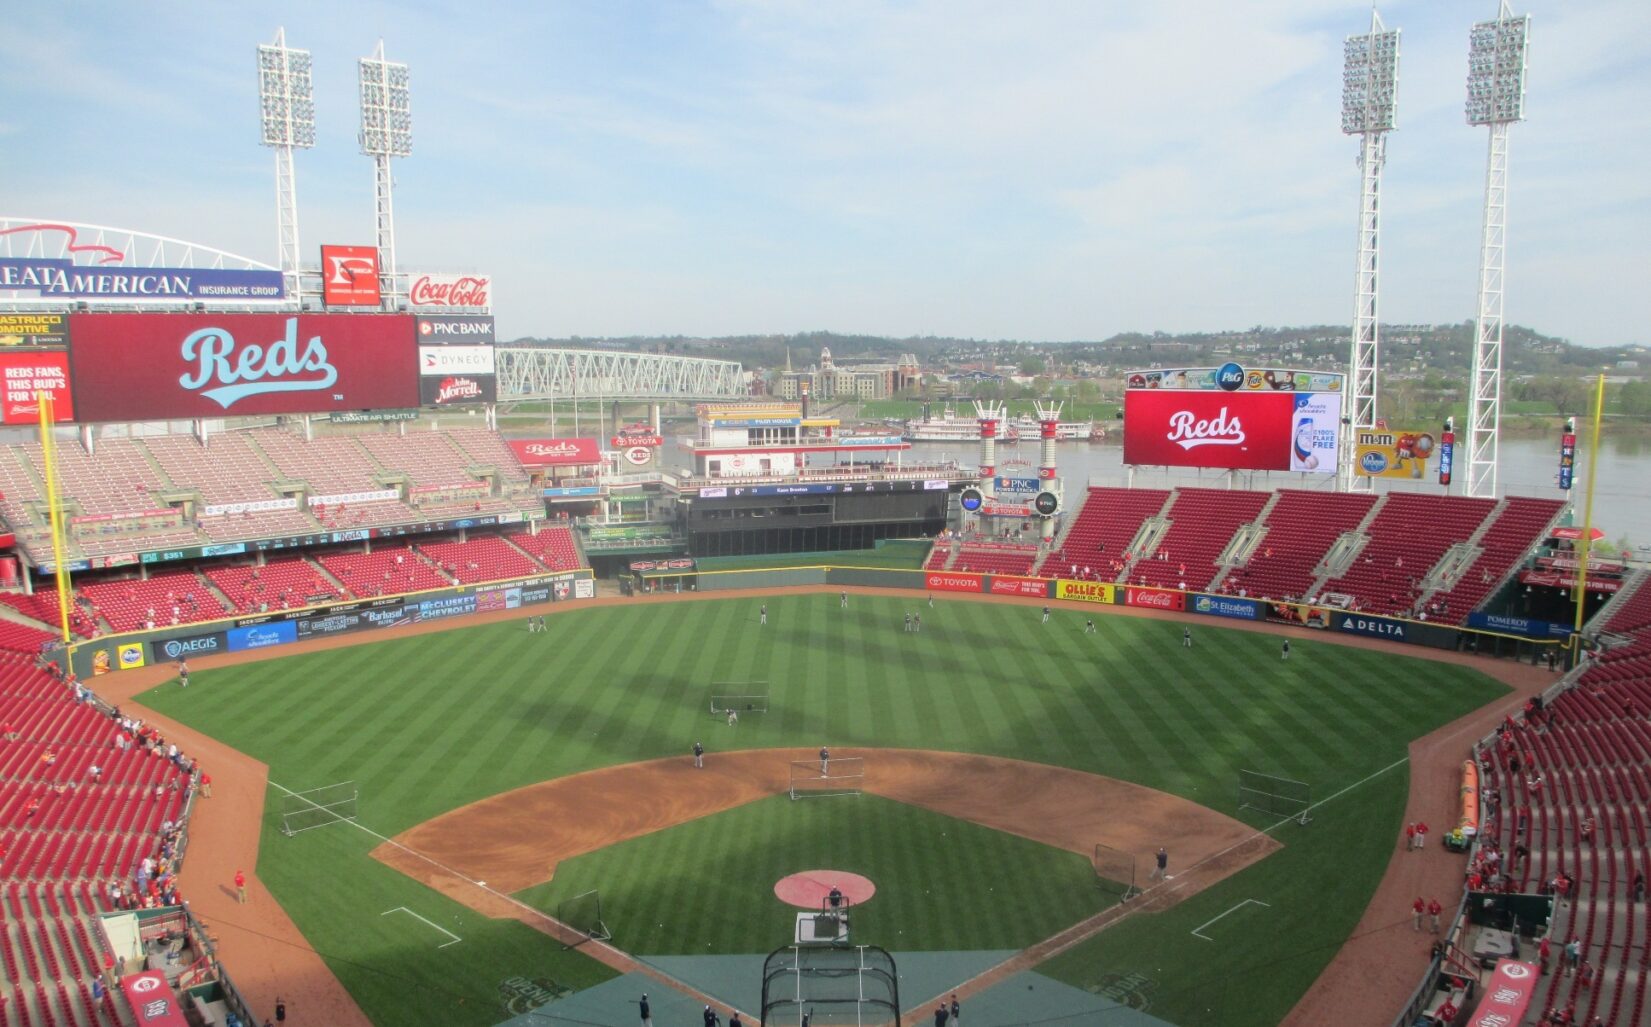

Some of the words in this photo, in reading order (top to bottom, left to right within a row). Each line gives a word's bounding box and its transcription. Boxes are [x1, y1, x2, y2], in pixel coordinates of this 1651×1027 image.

[0, 266, 55, 285] EAT
[48, 269, 191, 294] AMERICAN
[200, 286, 249, 295] INSURANCE
[251, 287, 279, 296] GROUP
[411, 276, 489, 306] Coca-Cola
[433, 323, 459, 334] PNC
[460, 323, 492, 334] BANK
[180, 317, 338, 409] Reds
[441, 355, 487, 364] DYNEGY
[5, 368, 33, 378] REDS
[35, 366, 65, 378] FANS,
[1222, 373, 1241, 382] P&G
[7, 380, 32, 389] THIS
[34, 379, 65, 389] BUD'S
[453, 378, 470, 387] John
[1247, 375, 1263, 385] Tide
[8, 391, 29, 401] FOR
[435, 382, 480, 403] Morrell
[333, 414, 368, 422] ULTIMATE
[369, 413, 382, 421] AIR
[384, 412, 416, 420] SHUTTLE
[1167, 407, 1245, 450] Reds
[525, 442, 580, 456] Reds
[1011, 480, 1032, 488] PNC
[943, 579, 977, 587] TOYOTA
[421, 596, 476, 611] McCLUSKEY
[1137, 591, 1171, 606] Coca-Cola
[421, 603, 476, 618] CHEVROLET
[1220, 602, 1254, 613] Elizabeth
[369, 609, 403, 621] Barbasol
[1487, 615, 1528, 627] POMEROY
[1358, 620, 1403, 636] DELTA
[182, 637, 217, 653] AEGIS
[248, 638, 280, 648] shoulders
